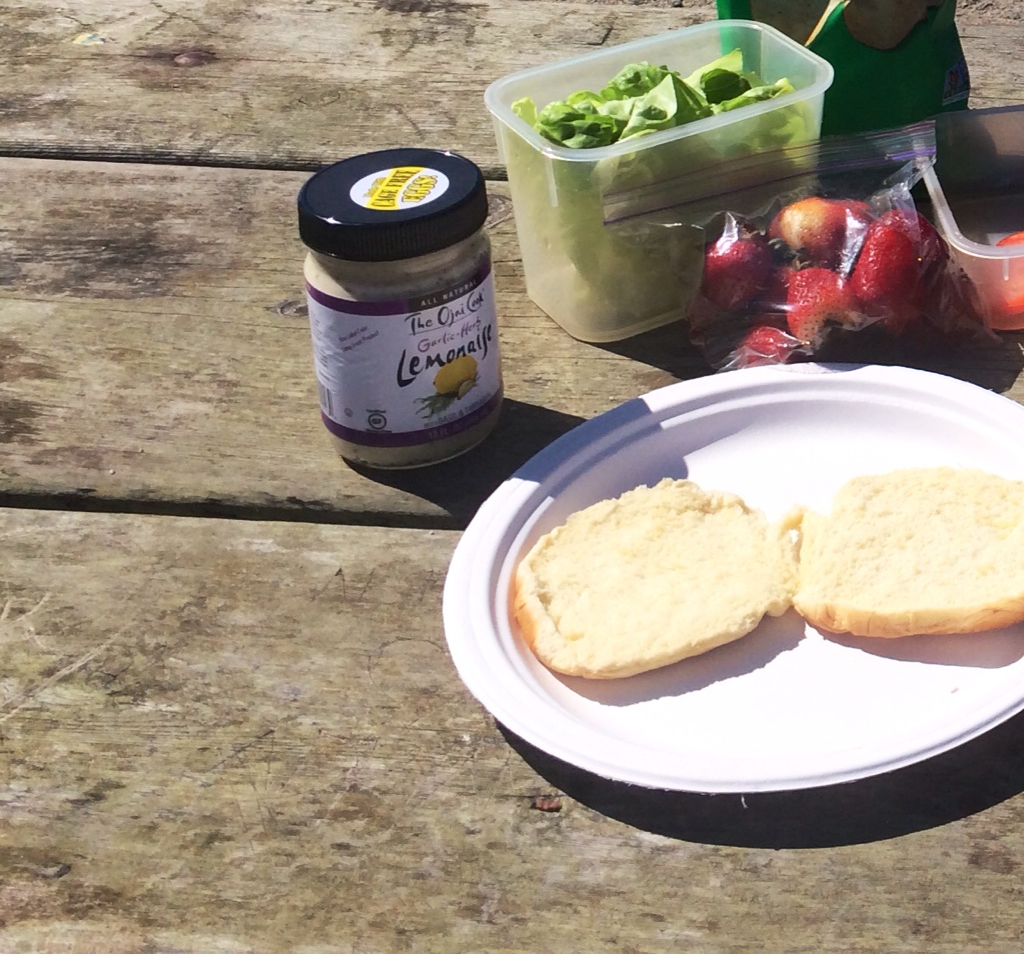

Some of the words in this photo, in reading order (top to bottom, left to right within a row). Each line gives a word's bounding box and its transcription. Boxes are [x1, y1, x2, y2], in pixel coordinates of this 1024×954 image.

[371, 189, 399, 207] CAGE
[386, 169, 421, 188] FREE
[402, 174, 438, 203] EGGS
[421, 297, 438, 307] ALL
[442, 278, 478, 300] NATURAL
[404, 312, 433, 336] The
[437, 303, 466, 328] Ojai
[417, 316, 482, 353] Garlic-Herb
